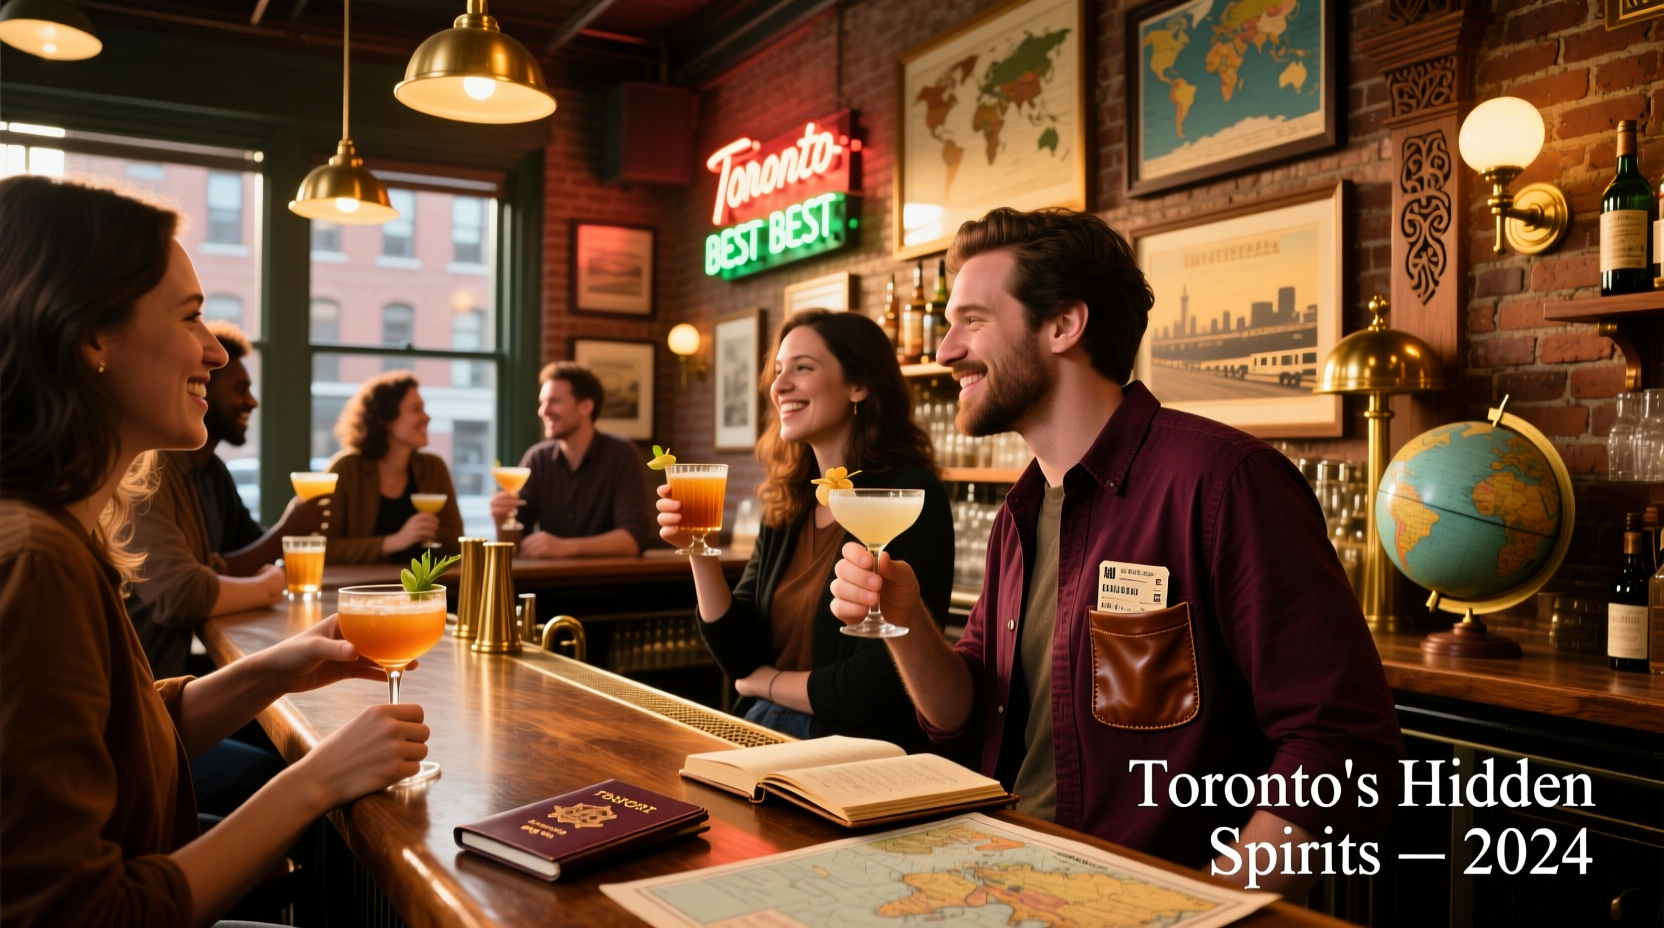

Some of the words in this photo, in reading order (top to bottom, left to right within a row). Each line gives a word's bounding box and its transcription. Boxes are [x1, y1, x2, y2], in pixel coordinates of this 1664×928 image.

[706, 122, 842, 226] Toronto
[705, 219, 764, 276] BEST
[769, 192, 836, 254] BEST
